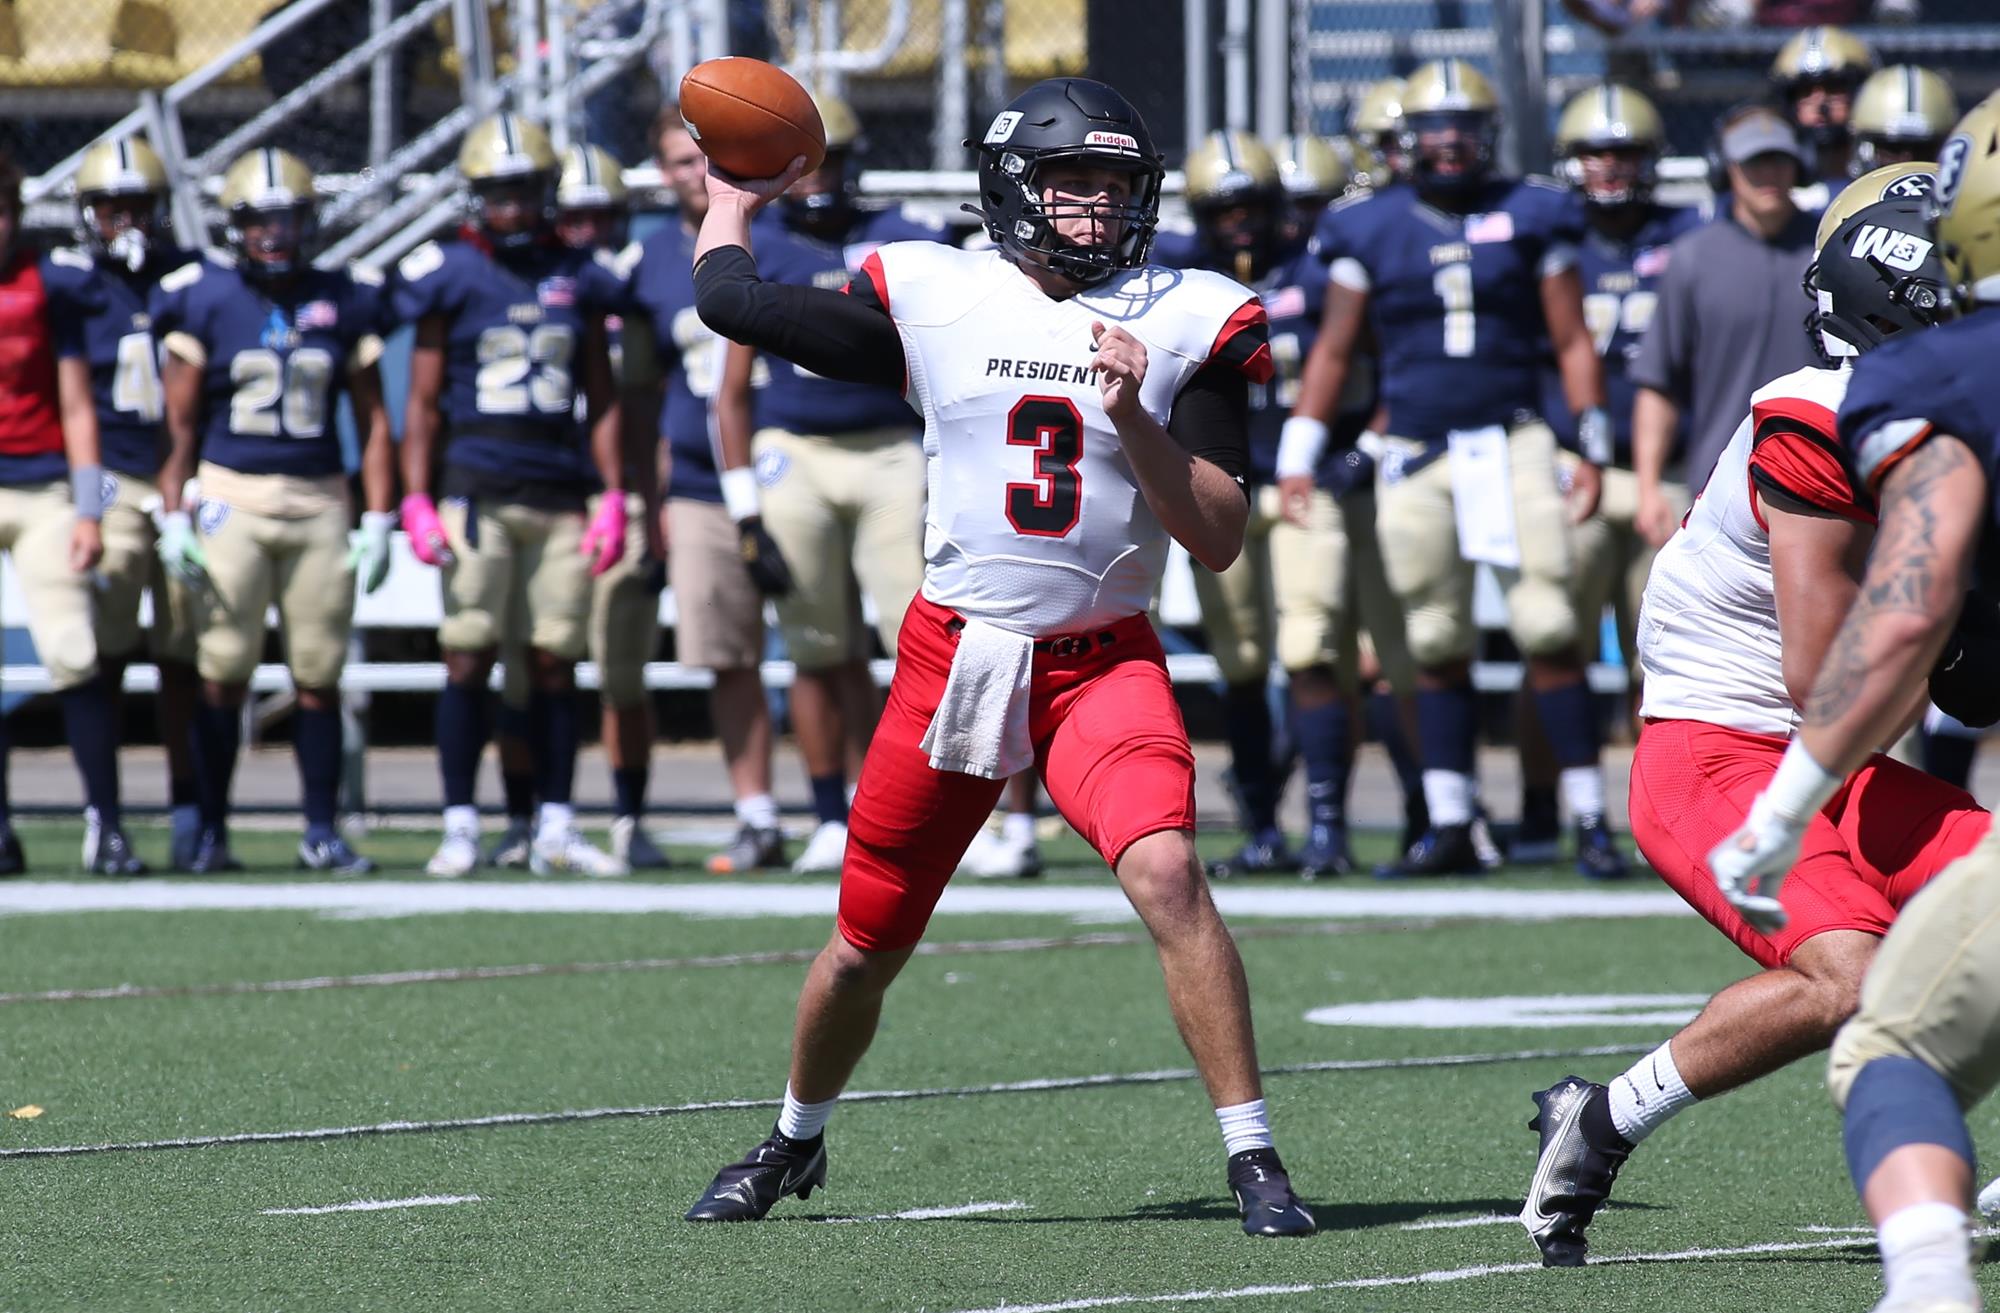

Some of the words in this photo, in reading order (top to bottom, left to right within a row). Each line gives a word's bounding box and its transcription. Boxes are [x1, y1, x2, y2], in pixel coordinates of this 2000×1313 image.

[1093, 133, 1134, 147] Riddell
[1432, 263, 1475, 357] 1
[230, 348, 333, 438] 20
[1005, 394, 1084, 538] 3
